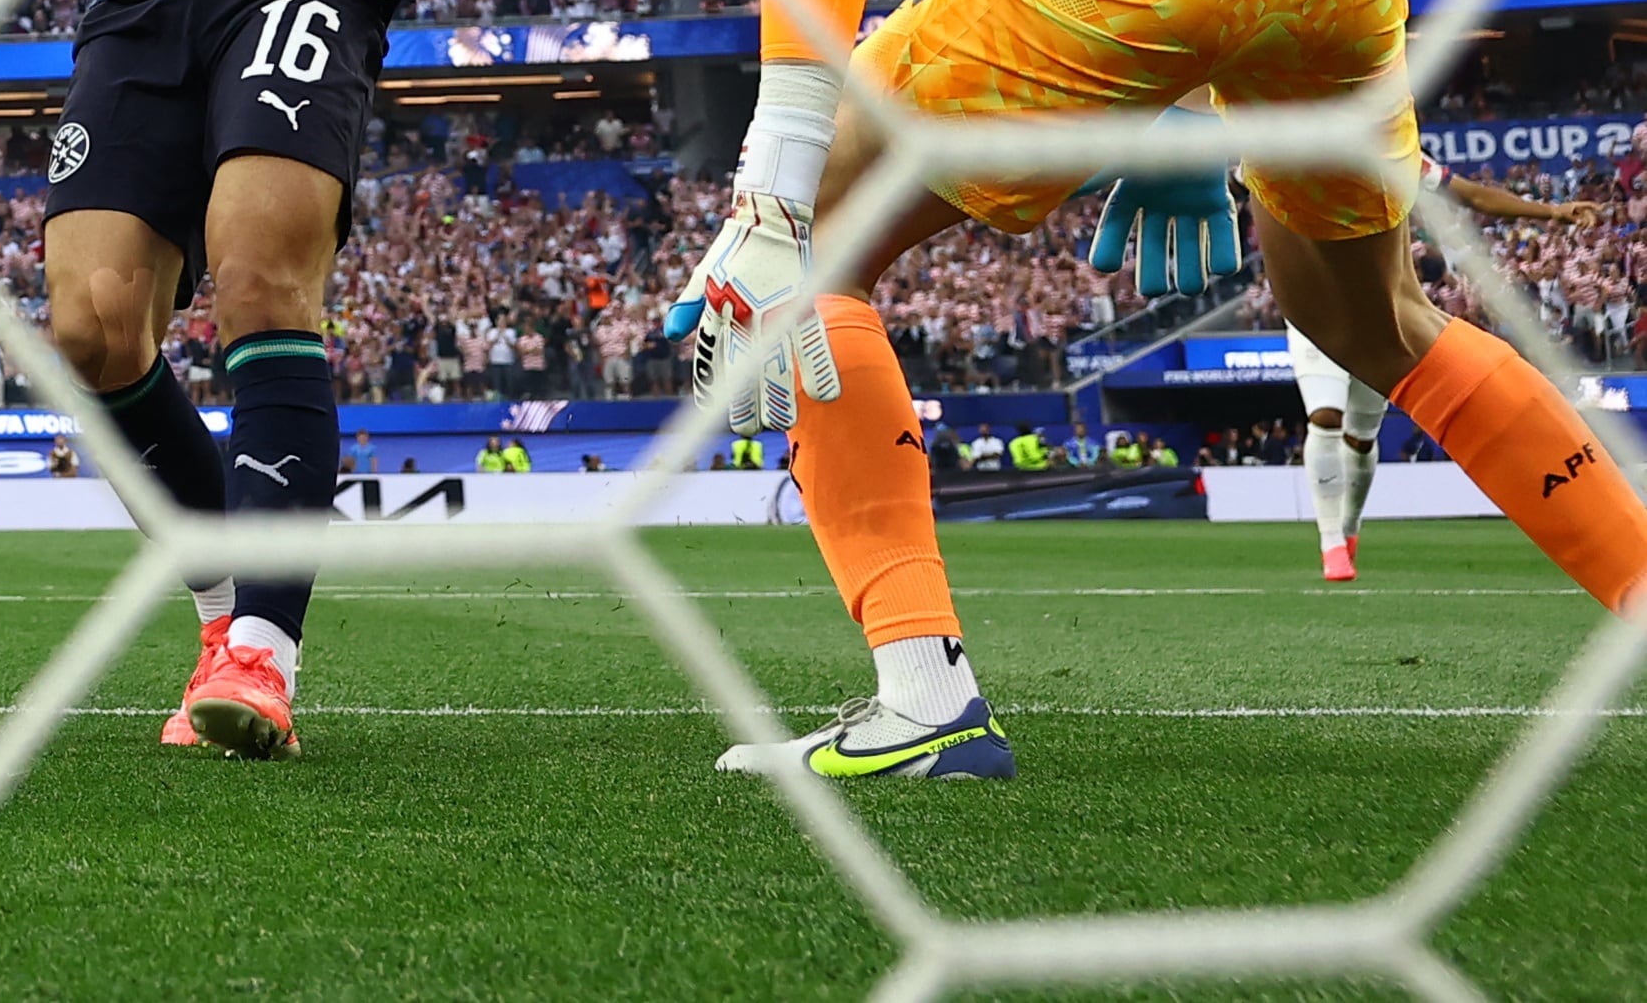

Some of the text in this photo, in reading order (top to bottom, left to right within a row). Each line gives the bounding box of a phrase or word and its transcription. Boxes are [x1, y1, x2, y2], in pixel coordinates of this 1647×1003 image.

[1421, 129, 1497, 164] RLD
[1504, 124, 1589, 161] CUP
[24, 413, 84, 435] WORL
